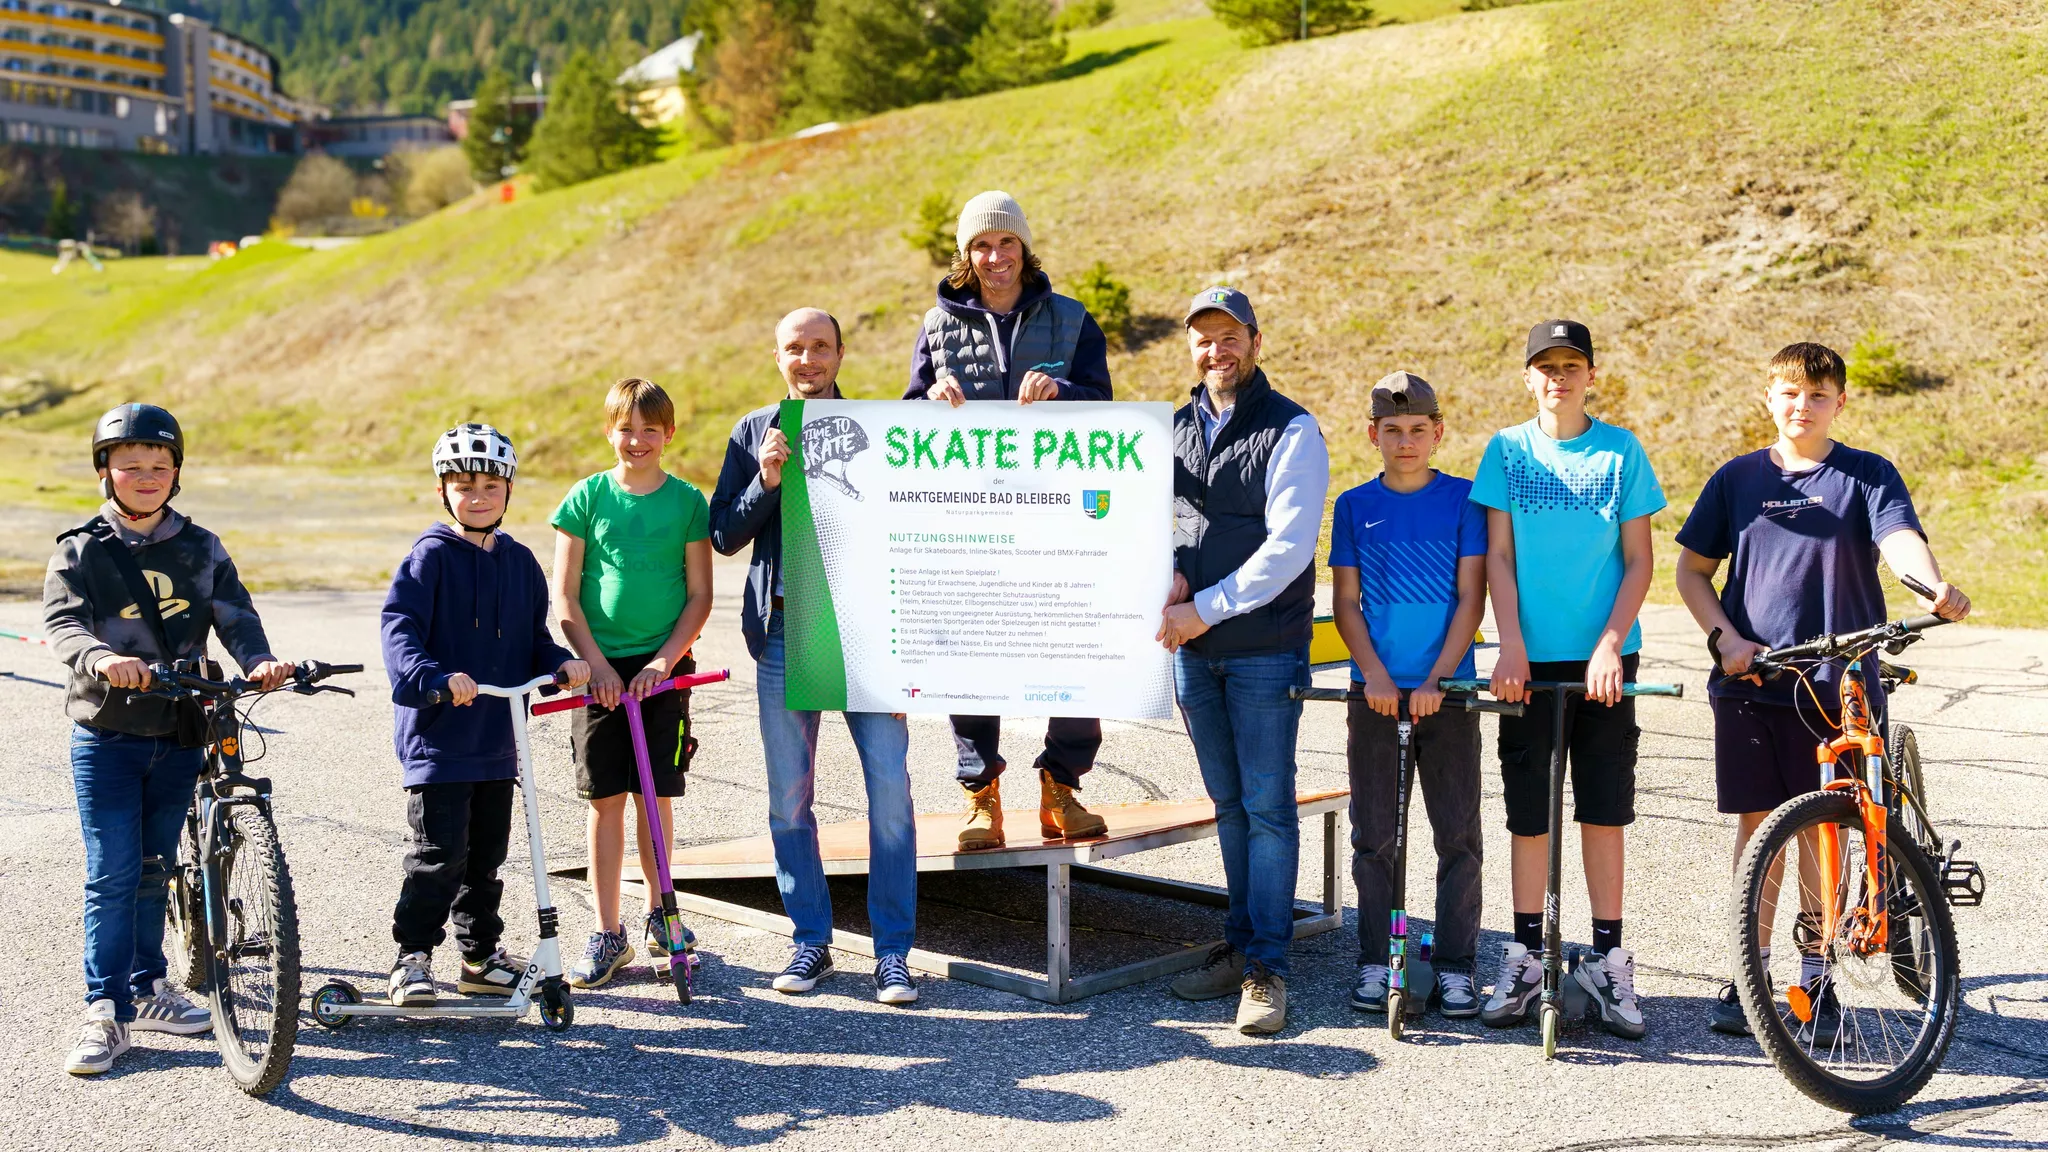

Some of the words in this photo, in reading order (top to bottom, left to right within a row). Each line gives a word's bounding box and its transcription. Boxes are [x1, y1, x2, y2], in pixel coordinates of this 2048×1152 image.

[803, 426, 831, 440] TIME
[832, 417, 850, 433] TO
[803, 433, 855, 470] SKATE
[885, 425, 1019, 471] SKATE
[1032, 428, 1146, 472] PARK
[889, 491, 987, 504] MARKTGEMEINDE
[990, 492, 1013, 504] BAD
[1016, 493, 1071, 505] BLEIBERG
[1762, 496, 1823, 508] HOLLISTER
[945, 509, 1014, 517] Naturparkgemeinde
[889, 532, 1015, 544] NUTZUNGSHINWEISE
[889, 547, 912, 556] Anlage
[914, 547, 923, 555] für
[924, 547, 968, 557] Skateboards,
[970, 548, 1013, 557] Inline-Skates,
[1015, 548, 1040, 556] Scooter
[1043, 548, 1056, 557] und
[1058, 549, 1108, 557] BMX-Fahrräder
[900, 568, 917, 576] Diese
[918, 568, 940, 578] Anlage
[951, 569, 964, 577] kein
[965, 569, 996, 578] Spielplatz
[900, 579, 926, 588] Nutzung
[928, 579, 936, 587] für
[938, 580, 976, 589] Erwachsene,
[979, 581, 1017, 590] Jugendliche
[1019, 581, 1031, 589] und
[1032, 581, 1053, 589] Kinder
[1070, 582, 1091, 590] Jahren
[900, 589, 911, 597] Der
[957, 591, 1001, 599] sachgerechter
[1003, 592, 1060, 600] Schutzausrüstung
[900, 599, 920, 607] (Helm,
[922, 599, 963, 608] Knieschützer,
[965, 600, 1019, 609] Ellbogenschützer
[1054, 601, 1088, 610] empfohlen
[900, 608, 911, 616] Die
[912, 609, 938, 617] Nutzung
[953, 610, 993, 618] ungeeigneter
[995, 610, 1032, 619] Ausrüstung,
[1085, 612, 1144, 621] Straßenfahrrädern,
[944, 619, 984, 627] Sportgeräten
[1002, 620, 1039, 628] Spielzeugen
[1068, 621, 1096, 629] gestattet
[901, 627, 908, 635] Es
[912, 639, 934, 647] Anlage
[950, 639, 959, 647] bei
[961, 640, 982, 648] Nässe,
[1008, 640, 1031, 648] Schnee
[1050, 641, 1074, 650] genutzt
[901, 649, 935, 657] Rollflächen
[937, 649, 948, 657] und
[950, 650, 998, 658] Skate-Elemente
[1001, 650, 1025, 659] müssen
[1040, 651, 1085, 661] Gegenständen
[1087, 652, 1125, 662] freigehalten
[921, 692, 1010, 701] familienfreundlichegemeinde
[1025, 691, 1058, 701] unicef
